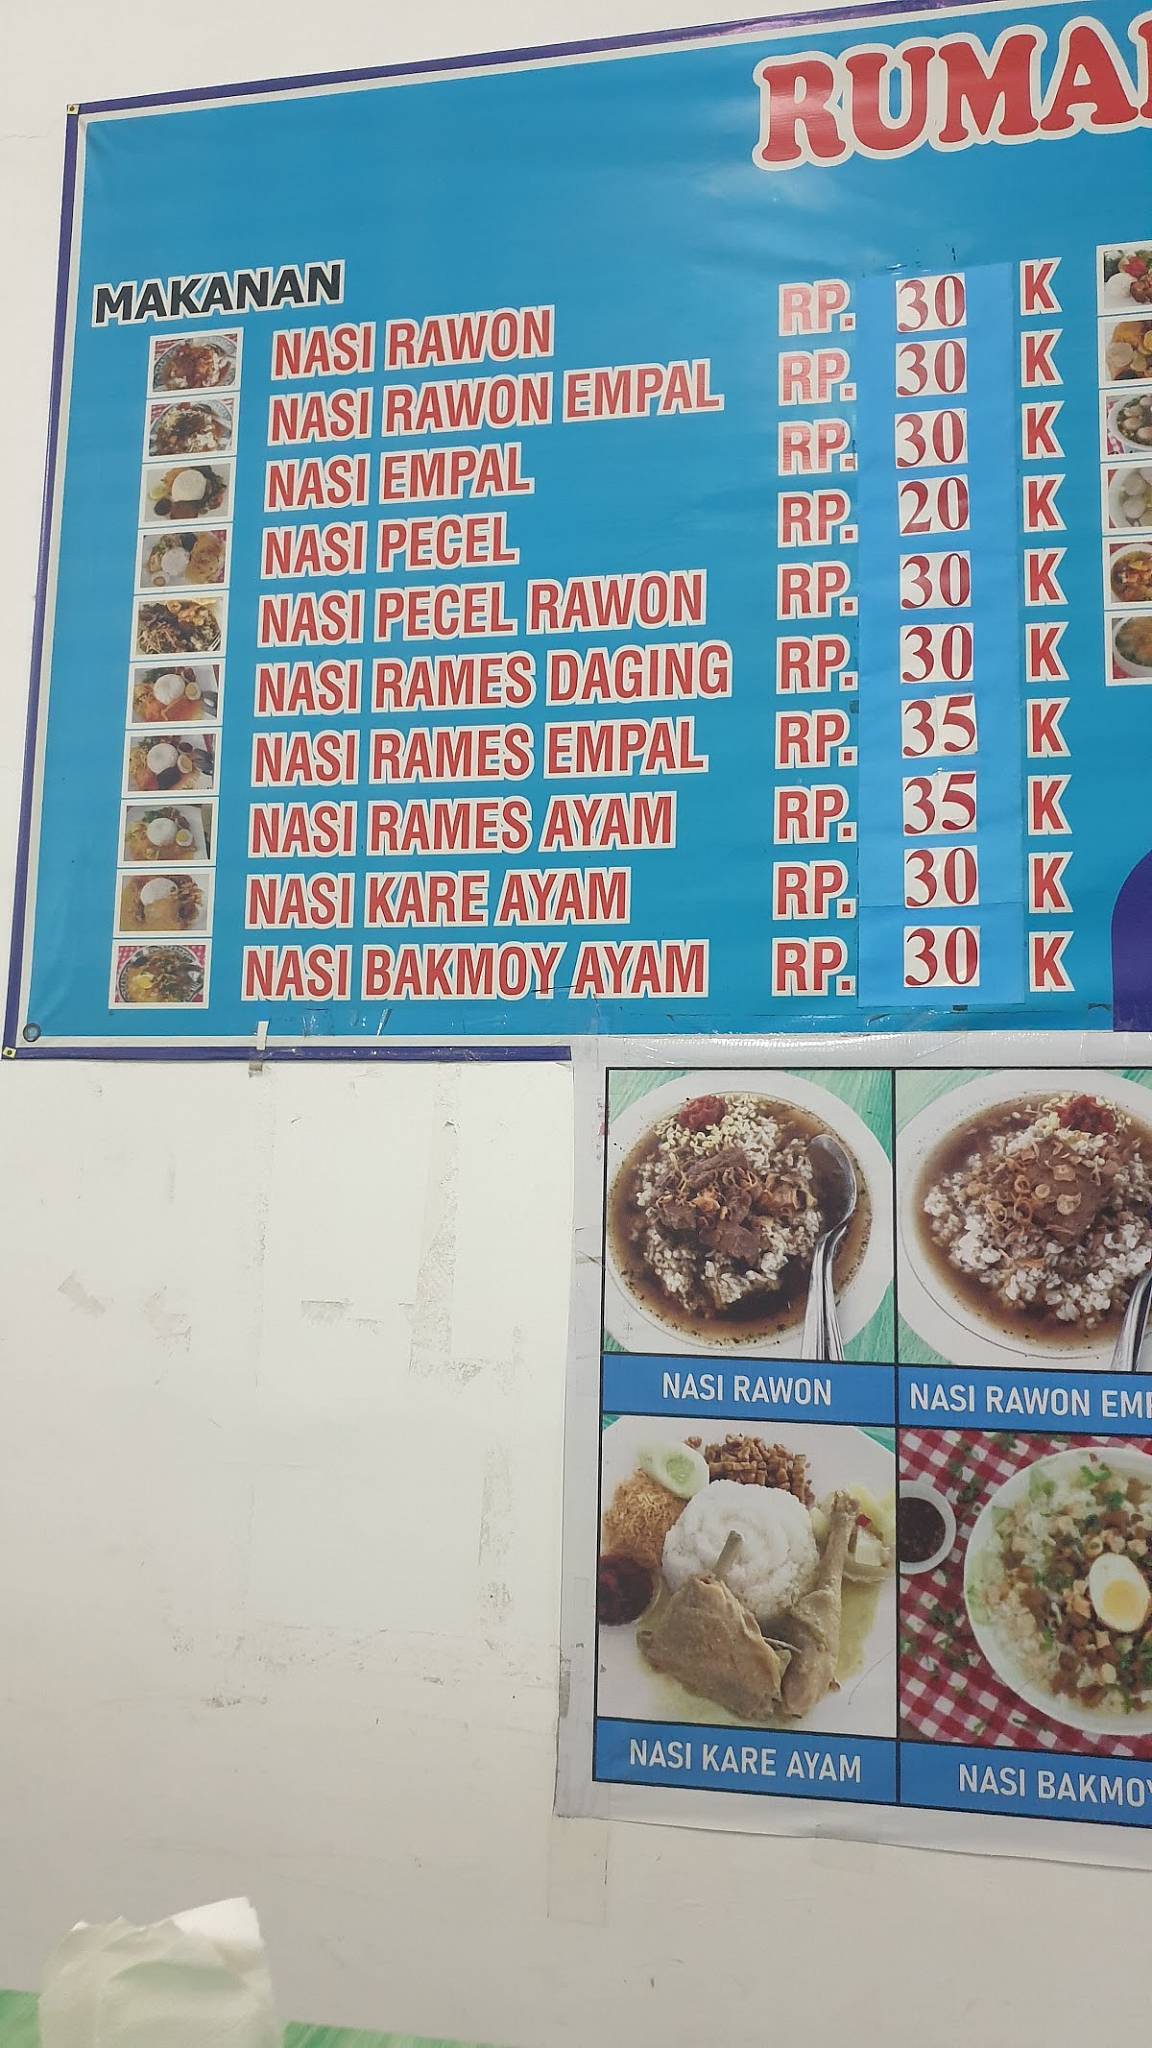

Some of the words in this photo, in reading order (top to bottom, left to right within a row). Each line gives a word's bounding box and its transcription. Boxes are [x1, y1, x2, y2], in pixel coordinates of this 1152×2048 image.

[93, 260, 345, 326] MAKANAN
[273, 324, 373, 379] NASI
[386, 308, 552, 369] RAWON
[782, 283, 854, 333] RP.
[898, 275, 965, 333] 30
[1022, 261, 1055, 314] K
[269, 390, 371, 444] NASI
[384, 375, 551, 435] RAWON
[565, 362, 721, 421] EMPAL
[781, 352, 854, 403] RP.
[896, 340, 966, 398] 30
[1023, 333, 1056, 386] K
[266, 457, 368, 510] NASI
[381, 446, 531, 502] EMPAL
[781, 421, 855, 473] RP.
[895, 411, 965, 469] 30
[1024, 404, 1058, 457] K
[262, 524, 365, 578] NASI
[378, 515, 517, 571] PECEL
[780, 492, 855, 545] RP.
[901, 477, 969, 535] 20
[1025, 478, 1058, 530] K
[259, 591, 362, 646] NASI
[376, 585, 514, 640] PECEL
[529, 573, 704, 632] RAWON
[779, 564, 855, 618] RP.
[901, 553, 971, 610] 30
[1027, 551, 1060, 603] K
[256, 662, 360, 715] NASI
[373, 654, 533, 711] RAMES
[549, 643, 730, 704] DAGING
[778, 637, 855, 692] RP.
[901, 625, 973, 684] 30
[1028, 626, 1062, 680] K
[253, 733, 358, 786] NASI
[371, 726, 531, 782] RAMES
[546, 719, 706, 777] EMPAL
[777, 712, 855, 766] RP.
[902, 695, 977, 758] 35
[1030, 701, 1063, 755] K
[249, 804, 355, 856] NASI
[369, 799, 530, 854] RAMES
[542, 794, 673, 850] AYAM
[776, 787, 854, 842] RP.
[903, 772, 977, 837] 35
[1030, 778, 1065, 833] K
[247, 876, 352, 928] NASI
[366, 874, 487, 926] KARE
[497, 871, 628, 924] AYAM
[775, 863, 854, 918] RP.
[905, 847, 978, 909] 30
[1031, 855, 1066, 911] K
[244, 947, 350, 1000] NASI
[363, 945, 561, 999] BAKMOY
[572, 942, 706, 998] AYAM
[773, 940, 853, 994] RP.
[903, 926, 979, 988] 30
[1031, 935, 1067, 990] K
[662, 1371, 725, 1402] NASI
[733, 1376, 832, 1406] RAWON
[909, 1383, 976, 1412] NASI
[986, 1386, 1090, 1418] RAWON
[629, 1738, 692, 1770] NASI
[701, 1744, 777, 1777] KARE
[786, 1751, 862, 1783] AYAM
[958, 1764, 1027, 1797] NASI
